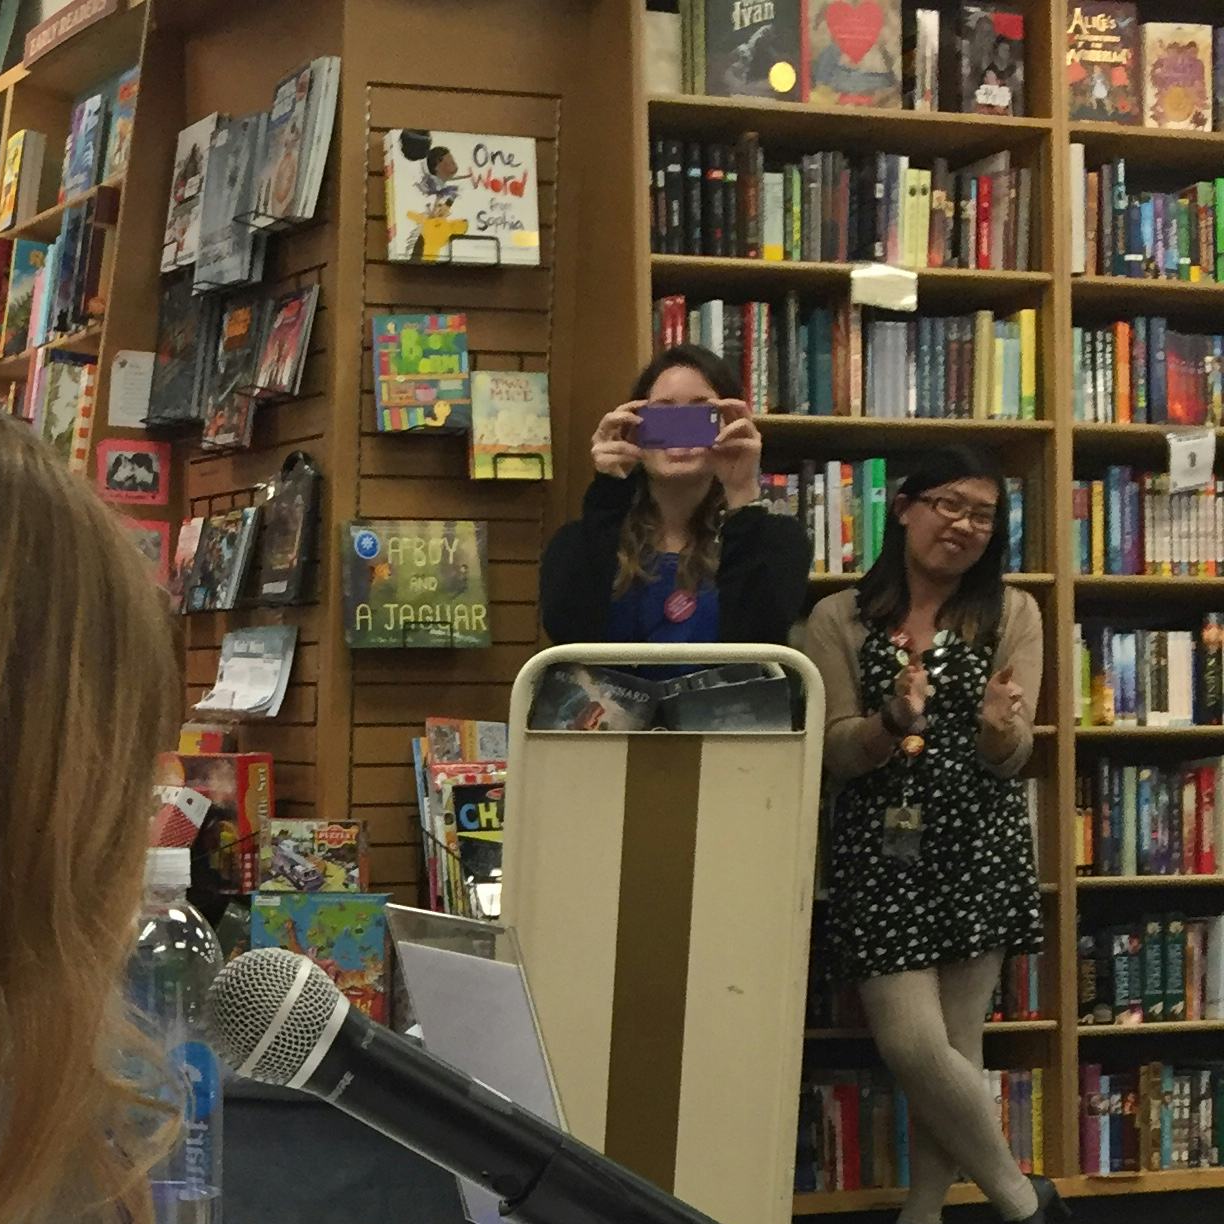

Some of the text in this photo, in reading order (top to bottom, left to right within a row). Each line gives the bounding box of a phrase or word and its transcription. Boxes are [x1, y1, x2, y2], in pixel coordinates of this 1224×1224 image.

[732, 1, 775, 32] Ivan
[473, 143, 521, 167] One
[469, 167, 528, 198] Word
[413, 536, 460, 567] BOY
[409, 576, 438, 591] AND
[355, 603, 488, 631] A JAGUAR
